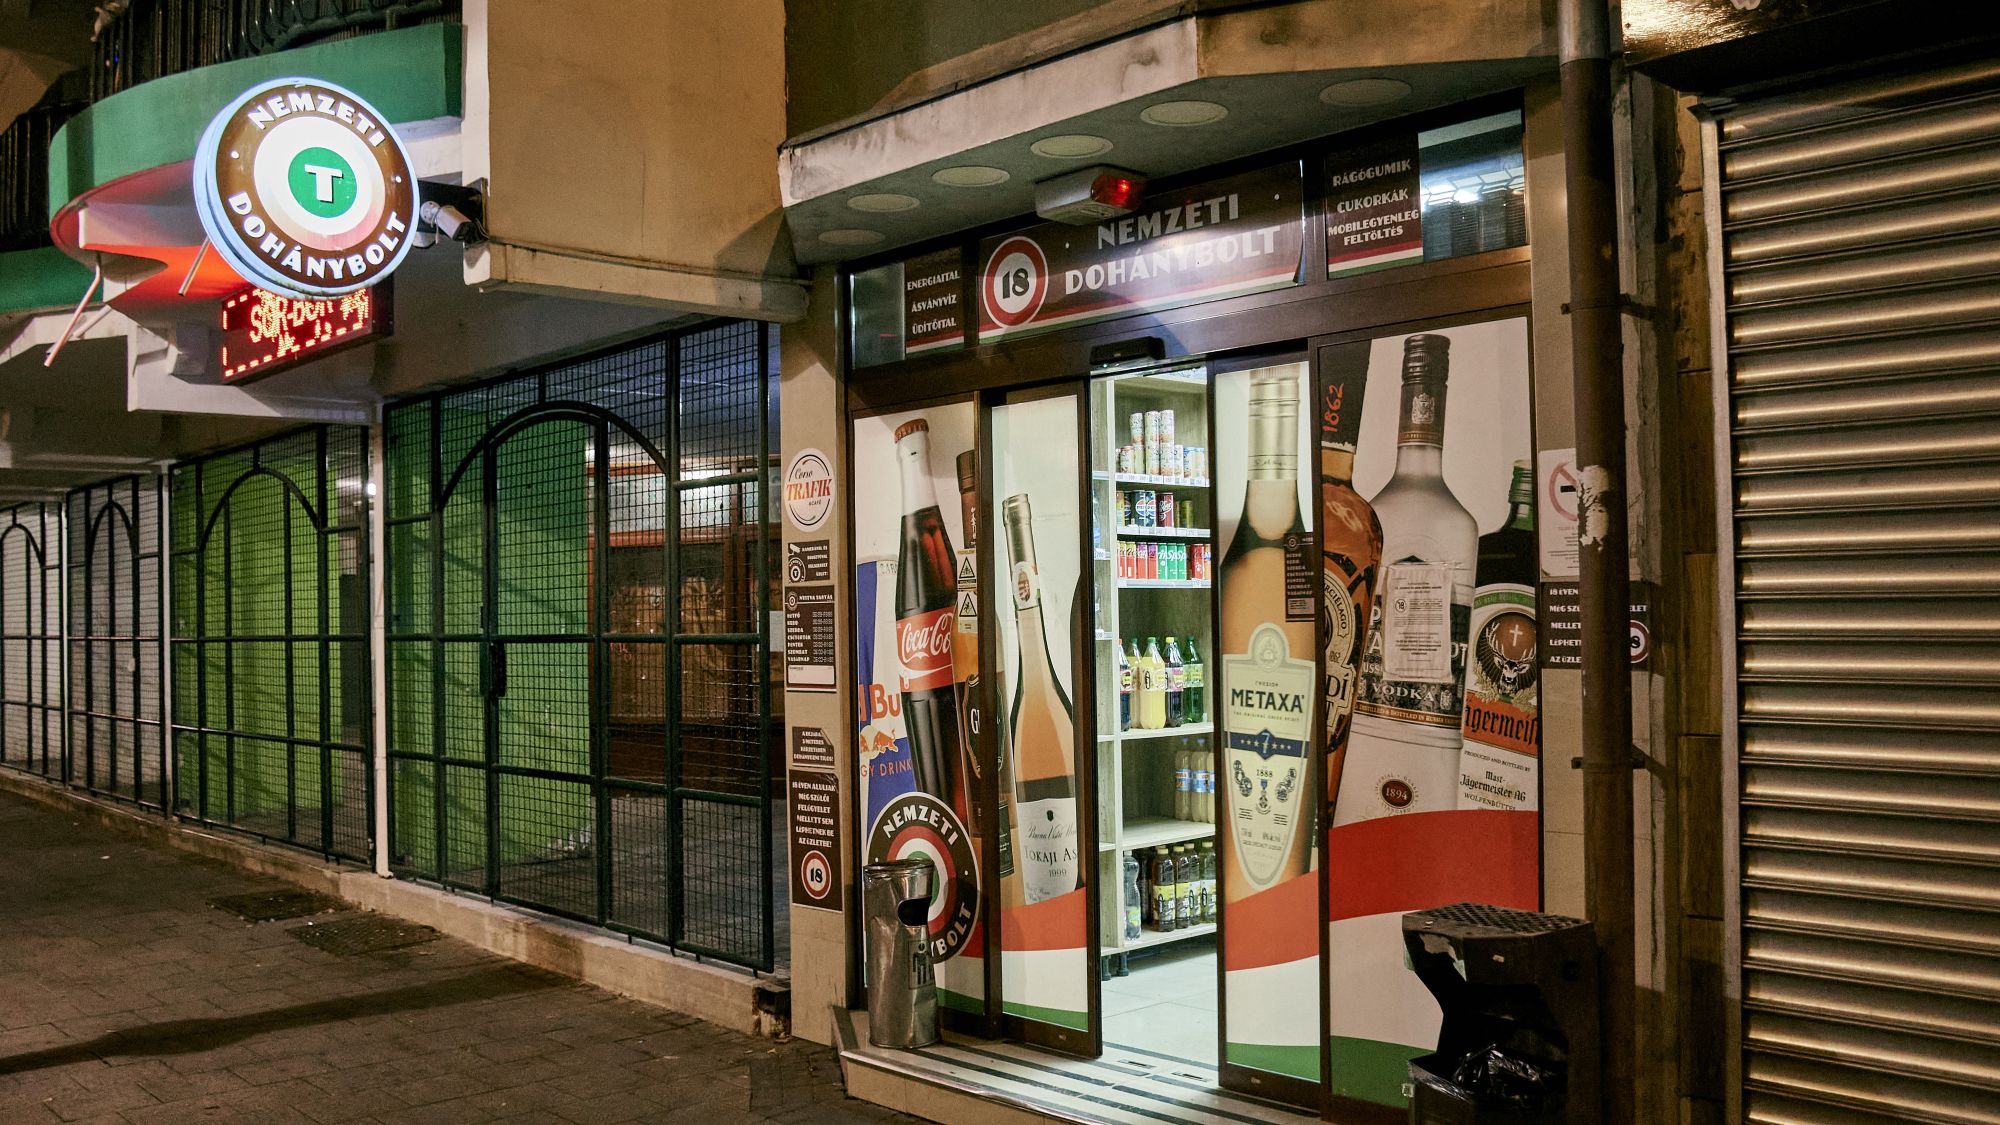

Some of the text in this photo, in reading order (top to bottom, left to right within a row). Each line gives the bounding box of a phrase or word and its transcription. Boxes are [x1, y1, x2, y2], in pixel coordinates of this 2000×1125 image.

[248, 92, 386, 147] NEMZETI
[304, 163, 343, 203] T
[1332, 158, 1411, 187] RÁGÓGUMIK
[1336, 188, 1409, 214] CUKORKÁK
[1098, 193, 1240, 250] NEMZETI
[1327, 209, 1420, 237] MOBILEGYENLEG
[228, 191, 406, 280] DOHÁNYBOLT
[1343, 225, 1404, 247] FELTÖLTÉS
[1065, 225, 1281, 295] DOHÁNYBOLT
[907, 270, 960, 291] ENERGIAITAL
[1001, 268, 1030, 299] 18
[911, 293, 957, 313] ÁSVÁNYVÍZ
[912, 317, 957, 335] ÜDÍTŐITAL
[1321, 383, 1344, 433] 1862
[786, 479, 832, 501] TRAFIK
[1549, 588, 1579, 596] 18 ÉVEN
[1549, 605, 1566, 613] MÉG
[1549, 639, 1581, 647] LÉPHET
[1231, 688, 1304, 713] METAXA
[1372, 682, 1435, 702] VODKA
[880, 759, 912, 777] DRINK
[1464, 750, 1490, 761] PRODUCED
[1502, 760, 1524, 771] BOTTLED
[1256, 769, 1273, 778] 1888
[1386, 787, 1407, 800] 1894
[1459, 774, 1513, 798] Jägermeister
[796, 814, 834, 825] MELLETT SEM
[797, 804, 831, 814] FELÜGYELET
[826, 829, 835, 837] BE
[882, 804, 959, 846] NEMZETI
[1024, 845, 1057, 866] TOKAJI
[810, 867, 823, 883] 18
